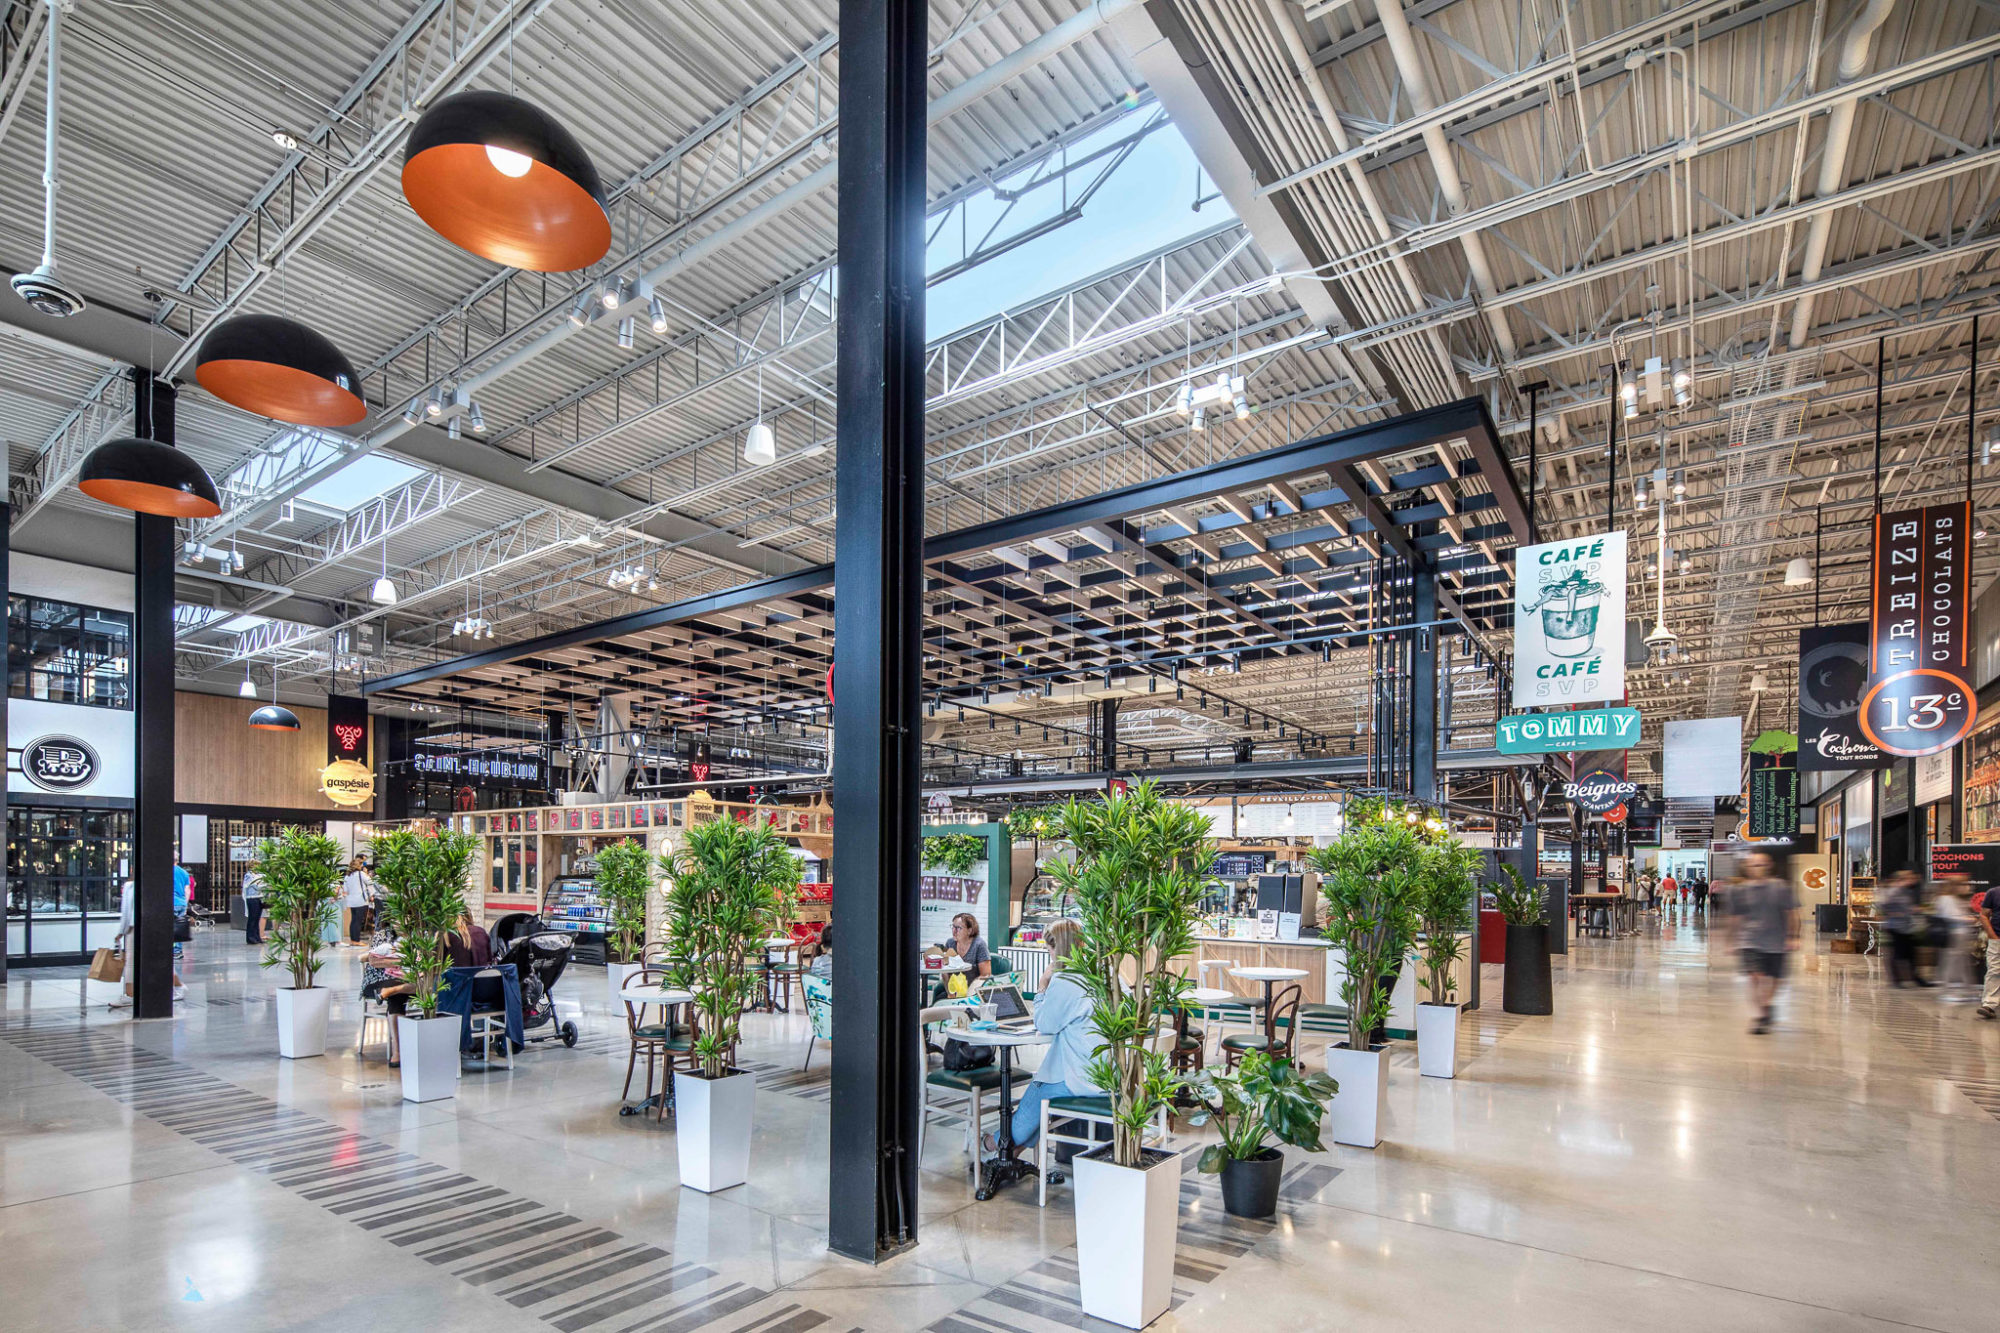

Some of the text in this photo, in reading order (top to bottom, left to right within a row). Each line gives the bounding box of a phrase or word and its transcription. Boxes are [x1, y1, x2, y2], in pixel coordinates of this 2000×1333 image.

[1538, 538, 1605, 566] CAFÉ
[1889, 520, 1917, 666] TREIZE
[1932, 517, 1953, 662] CHOCOLATS
[1536, 656, 1602, 679] CAFÉ
[1535, 678, 1599, 697] SVP
[1500, 714, 1635, 743] TOMMY
[327, 779, 370, 788] gaspésie
[1563, 782, 1637, 801] Beignes
[1583, 800, 1615, 810] D'ANTAN
[1753, 772, 1763, 834] Sous les oliviers
[1932, 853, 1985, 861] COCHONS
